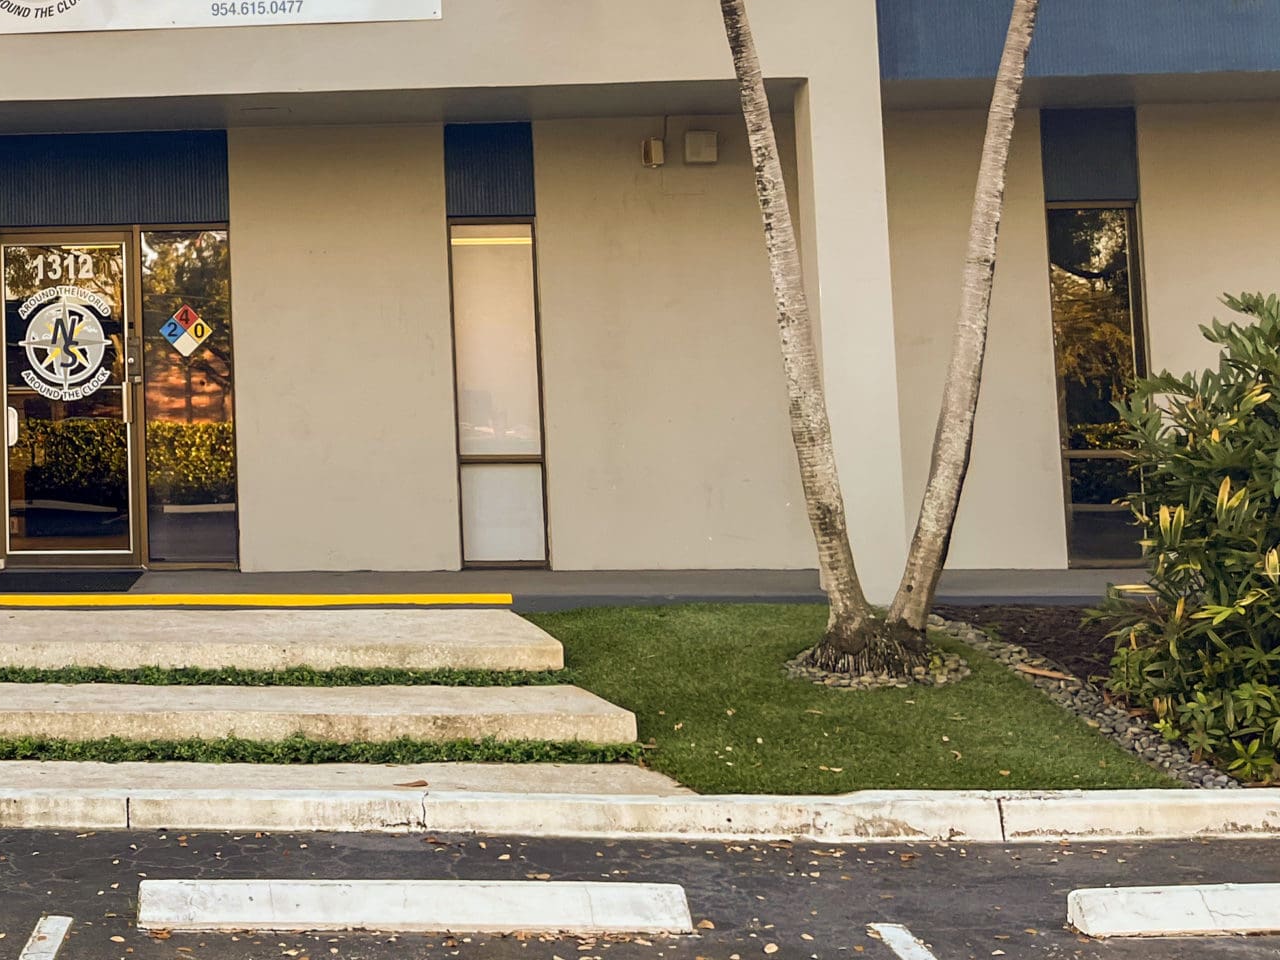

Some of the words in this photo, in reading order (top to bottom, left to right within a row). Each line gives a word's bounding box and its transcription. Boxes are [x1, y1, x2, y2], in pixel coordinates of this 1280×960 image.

[34, 5, 55, 19] THE
[211, 0, 304, 17] 954.615.0477
[32, 253, 95, 281] 1312
[19, 288, 57, 318] AROUND
[58, 287, 77, 297] THE
[78, 290, 110, 317] WORLD
[179, 309, 191, 325] 4
[167, 321, 178, 337] 2
[194, 323, 205, 339] 0
[23, 370, 60, 399] AROUND
[62, 391, 81, 400] THE
[82, 369, 109, 395] CLOCK
